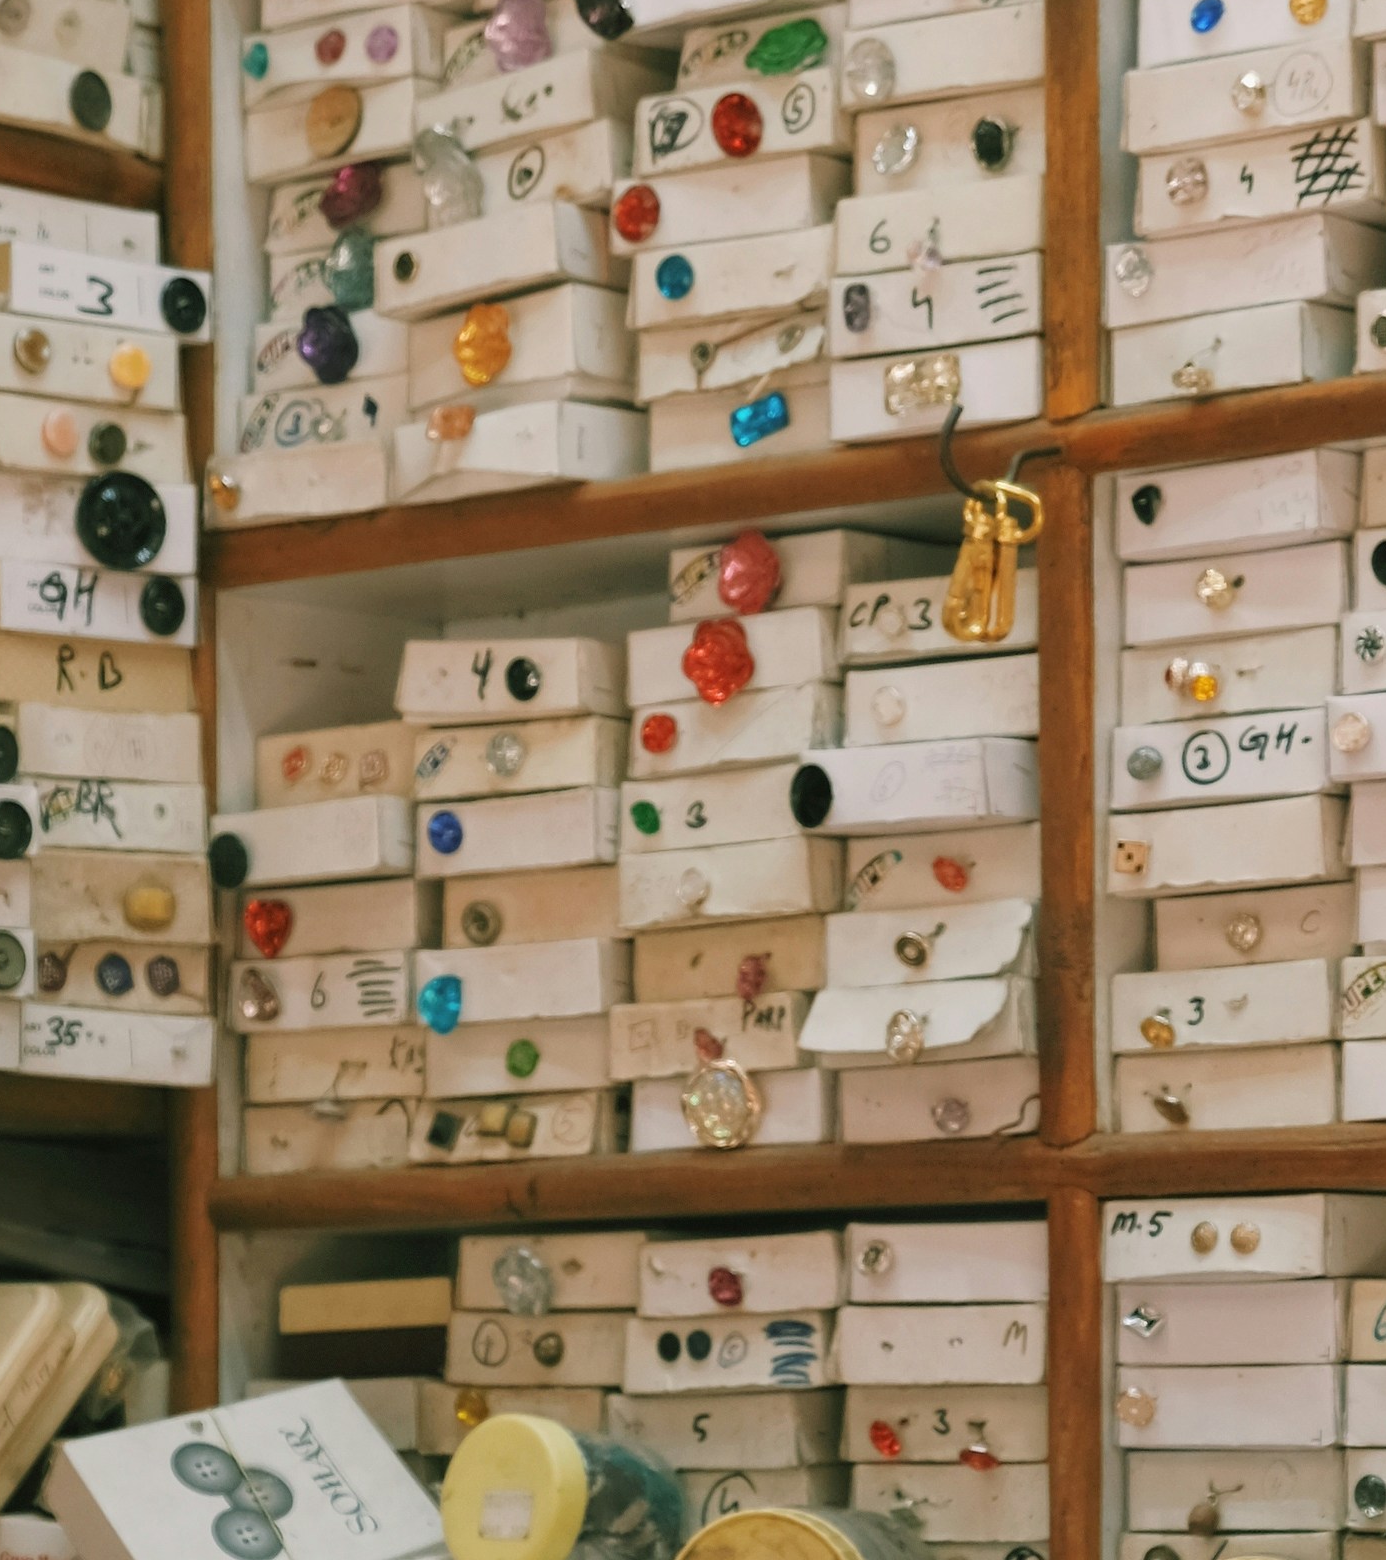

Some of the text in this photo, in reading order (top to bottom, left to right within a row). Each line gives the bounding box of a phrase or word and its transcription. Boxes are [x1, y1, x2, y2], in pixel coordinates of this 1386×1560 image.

[868, 219, 892, 256] 6
[905, 603, 936, 631] 3
[471, 648, 494, 701] 4
[310, 970, 328, 1010] 6
[1187, 995, 1205, 1024] 3
[692, 1413, 710, 1442] 5
[931, 1409, 951, 1435] 3
[277, 1414, 383, 1538] SOHLAR
